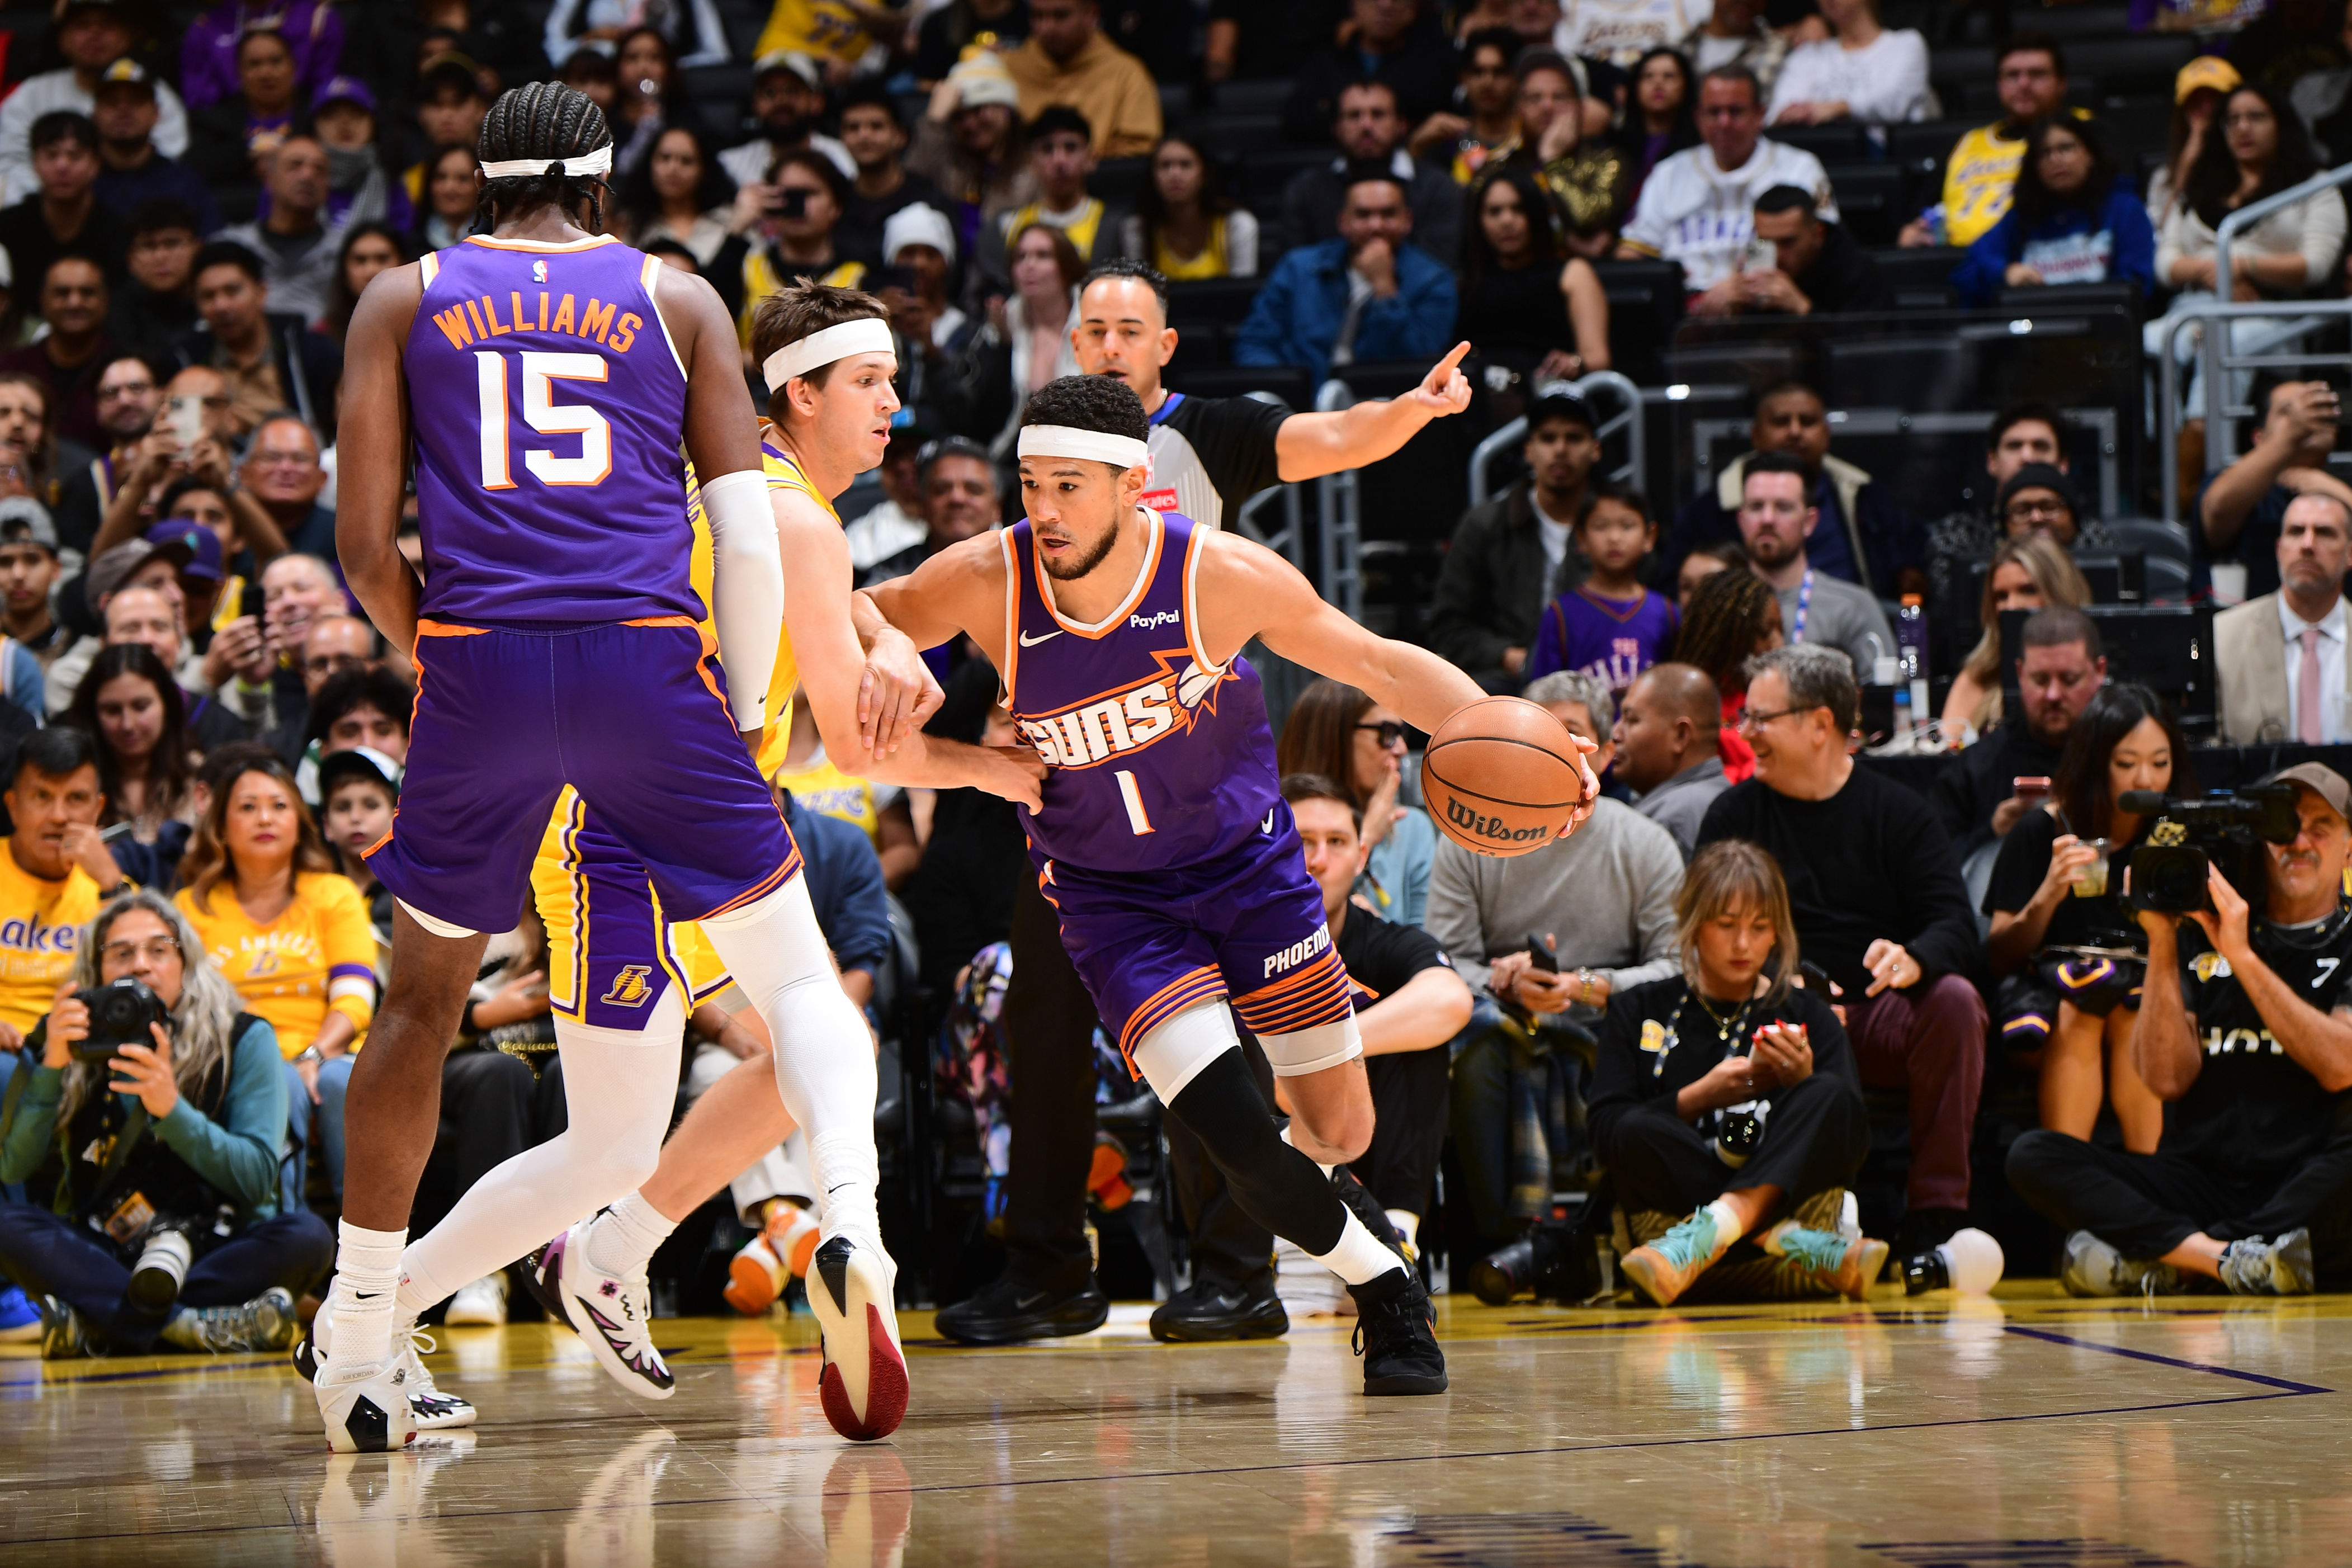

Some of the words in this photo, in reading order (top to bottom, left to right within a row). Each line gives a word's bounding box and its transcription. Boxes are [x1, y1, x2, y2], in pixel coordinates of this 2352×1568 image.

[432, 291, 643, 353] WILLIAMS
[473, 351, 612, 490] 15
[1130, 609, 1180, 630] PayPal
[1020, 682, 1174, 766] SUNS
[1113, 769, 1156, 835] 1
[1447, 795, 1548, 842] Wilson
[2311, 957, 2341, 989] 7
[352, 1370, 374, 1380] JORDAN
